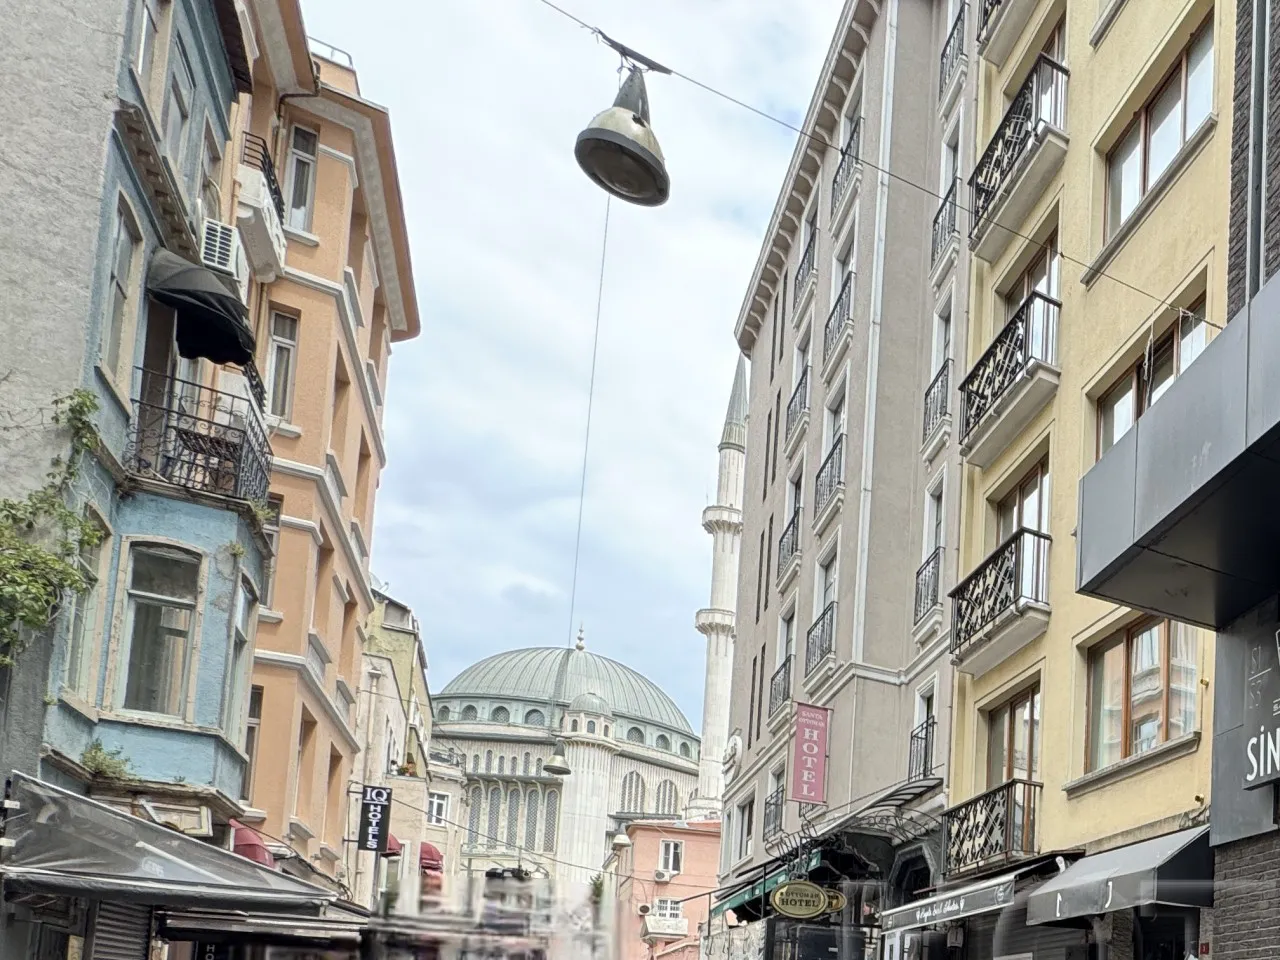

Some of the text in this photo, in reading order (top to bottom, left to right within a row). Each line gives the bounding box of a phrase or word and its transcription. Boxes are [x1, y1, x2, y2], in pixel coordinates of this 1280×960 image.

[802, 727, 819, 797] HOTEL
[364, 787, 388, 804] IQ
[366, 804, 382, 849] HOTELS
[781, 898, 819, 907] HOTEL
